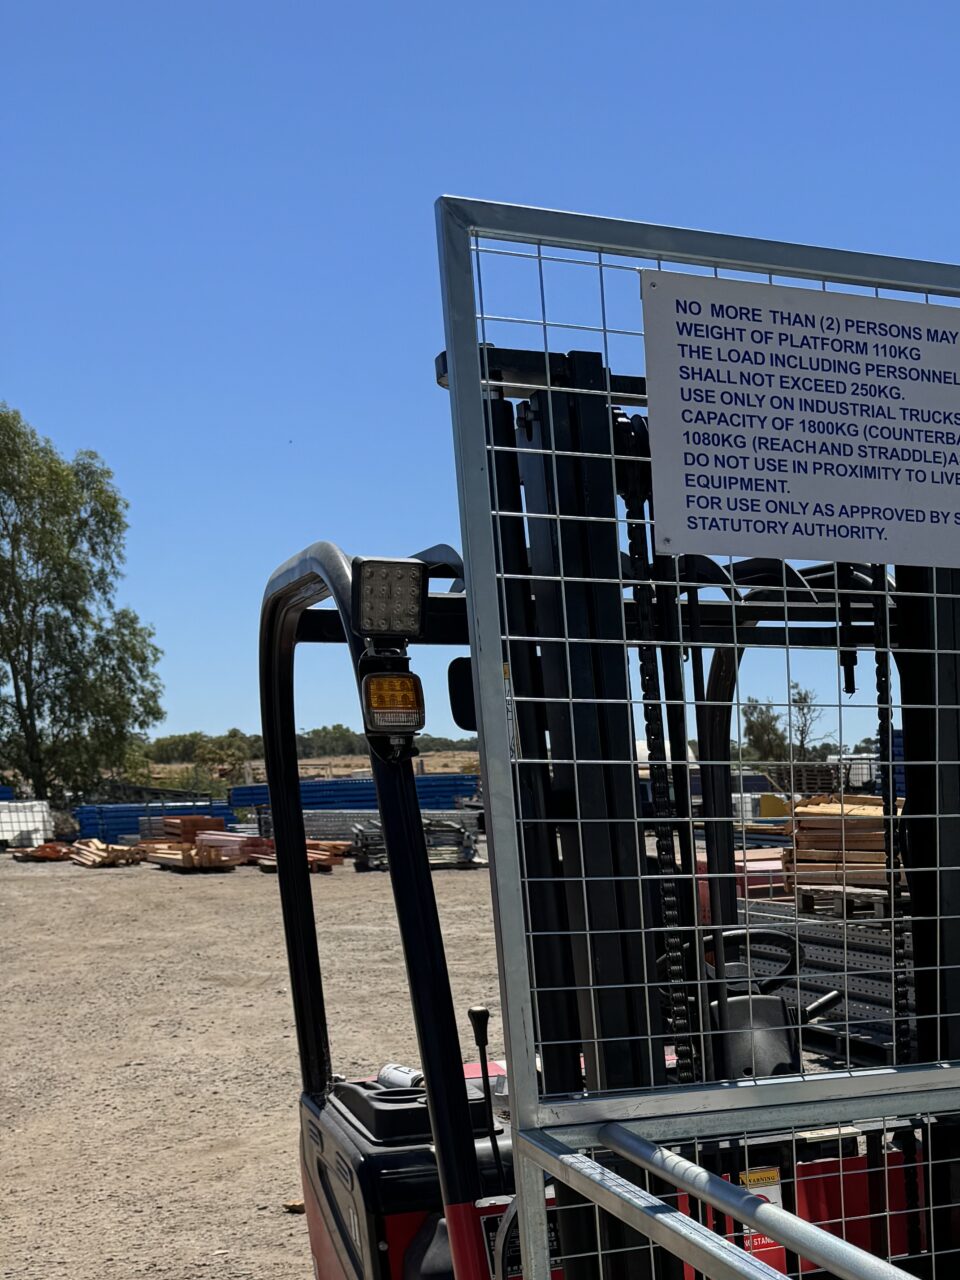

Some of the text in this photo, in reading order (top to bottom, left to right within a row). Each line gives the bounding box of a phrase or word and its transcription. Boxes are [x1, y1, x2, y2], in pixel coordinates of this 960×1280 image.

[676, 299, 702, 315] NO
[711, 304, 762, 322] MORE
[769, 310, 815, 328] THAN
[820, 316, 840, 335] (2)
[845, 319, 922, 340] PERSONS
[927, 328, 958, 344] MAY
[676, 321, 920, 360] WEIGHT OF PLATFORM 110KG
[677, 344, 712, 360] THE
[718, 348, 765, 365] LOAD
[770, 353, 860, 375] INCLUDING
[679, 366, 904, 400] SHALL NOT EXCEED 250KG.
[680, 387, 716, 404] USE
[720, 391, 766, 408] ONLY
[770, 396, 794, 410] ON
[799, 398, 896, 420] INDUSTRIAL
[682, 409, 768, 429] CAPACITY
[772, 417, 794, 431] OF
[800, 419, 858, 436] 1800KG
[683, 431, 746, 448] 1080KG
[752, 436, 816, 454] (REACH
[818, 442, 853, 456] AND
[684, 452, 709, 467] DO
[714, 454, 750, 470] NOT
[754, 457, 788, 472] USE
[793, 460, 808, 474] IN
[813, 462, 901, 480] PROXIMITY
[905, 469, 926, 482] TO
[685, 473, 790, 493] EQUIPMENT.
[686, 495, 722, 510] FOR
[727, 497, 761, 512] USE
[765, 500, 809, 515] ONLY
[838, 505, 926, 522] APPROVED
[930, 510, 950, 524] BY
[687, 516, 887, 540] STATUTORY AUTHORITY.
